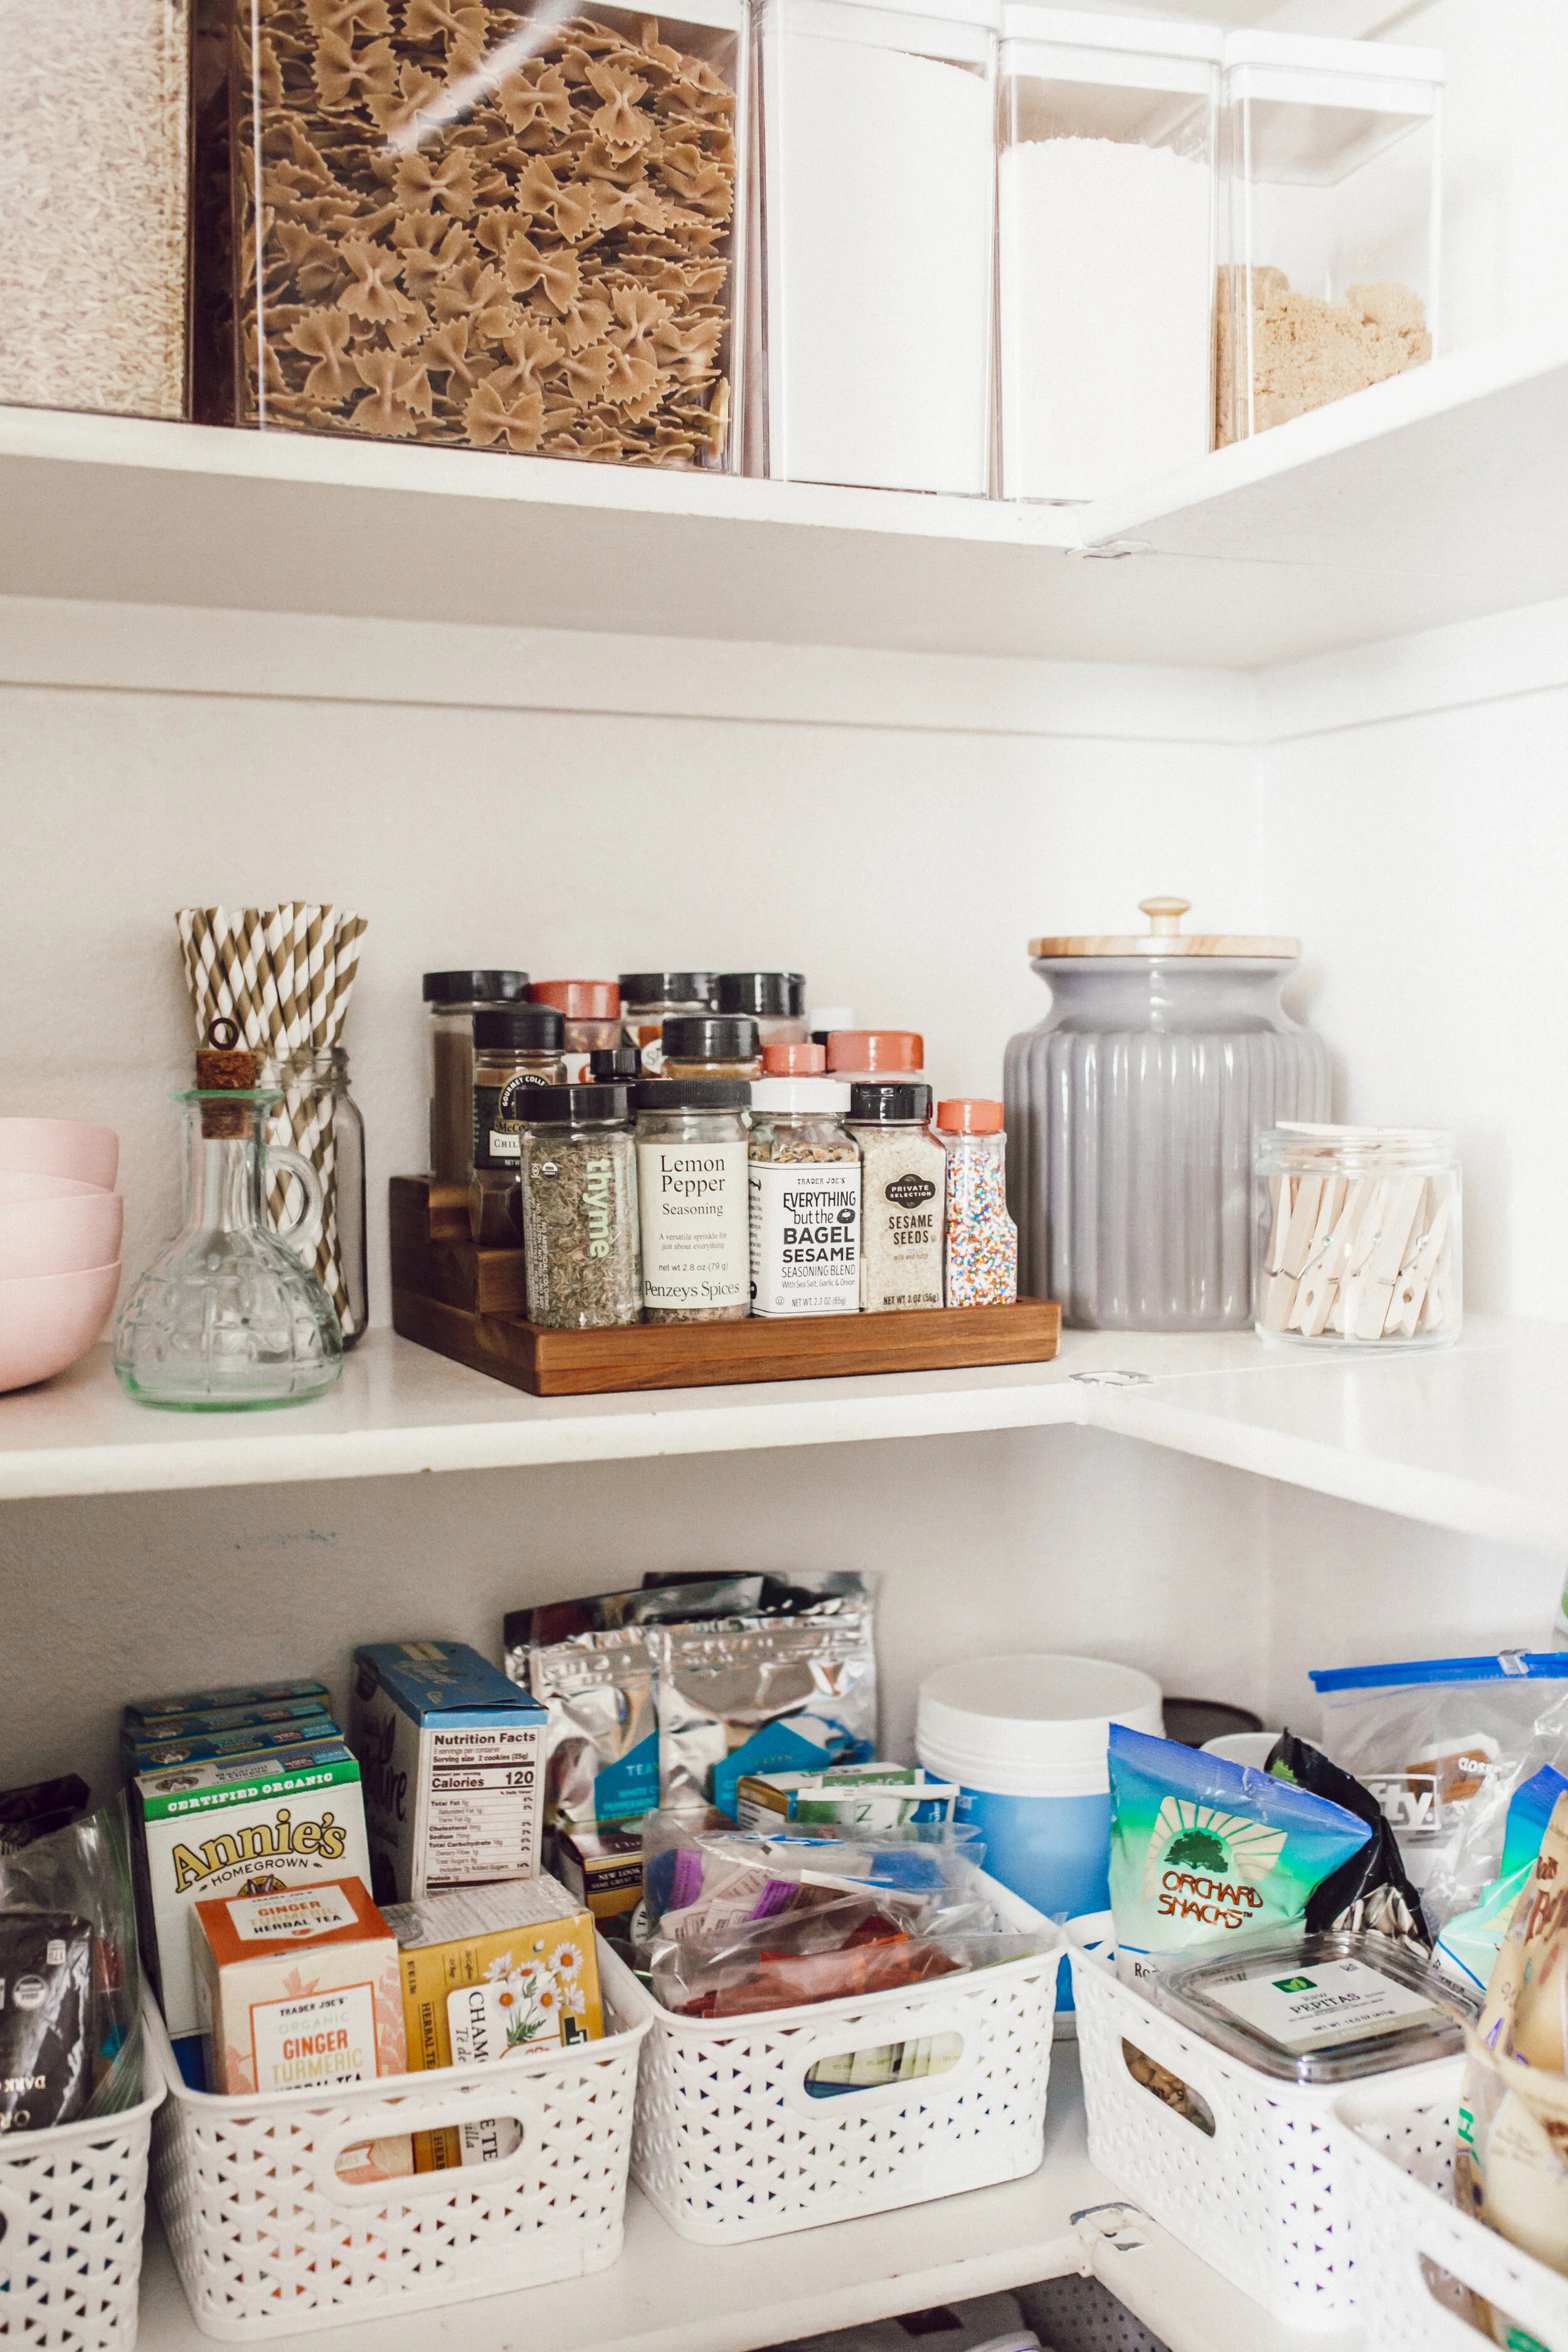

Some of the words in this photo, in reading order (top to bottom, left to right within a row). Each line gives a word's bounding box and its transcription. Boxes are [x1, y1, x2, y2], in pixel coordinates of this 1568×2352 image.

[502, 1076, 524, 1107] GOURMET
[660, 1155, 726, 1173] Lemon
[662, 1175, 726, 1197] Pepper
[891, 1184, 930, 1192] PRIVATE
[583, 1158, 612, 1258] thyme
[784, 1191, 856, 1208] EVERYTHING
[662, 1202, 724, 1217] Seasoning
[794, 1210, 813, 1224] but
[815, 1209, 834, 1224] the
[889, 1214, 933, 1230] SESAME
[693, 1232, 718, 1242] sprinkle
[784, 1226, 855, 1245] BAGEL
[893, 1231, 929, 1245] SEEDS
[661, 1242, 673, 1252] just
[693, 1242, 725, 1252] everything
[782, 1247, 855, 1263] SESAME
[682, 1263, 695, 1271] 2.8
[781, 1265, 829, 1278] SEASONING
[830, 1264, 856, 1276] BLEND
[645, 1280, 699, 1301] Penzeys
[701, 1281, 740, 1300] Spices
[781, 1280, 796, 1289] With
[819, 1278, 834, 1287] Garlic
[840, 1278, 856, 1286] Onion
[792, 1298, 802, 1306] NET
[815, 1298, 823, 1306] 2.3
[824, 1297, 831, 1305] OZ
[883, 1296, 895, 1305] NET
[896, 1295, 905, 1304] WT
[913, 1293, 921, 1303] OZ
[434, 1734, 495, 1745] Nutrition
[499, 1732, 536, 1743] Facts
[432, 1777, 484, 1788] Calories
[506, 1770, 534, 1785] 120
[167, 1787, 258, 1812] CERTIFIED
[262, 1772, 334, 1795] ORGANIC
[172, 1808, 347, 1894] Annie's
[211, 1858, 308, 1887] HOMEGROWN
[598, 1870, 617, 1881] NEW
[618, 1867, 641, 1878] LOOK
[591, 1880, 610, 1889] SAME
[1162, 1870, 1264, 1908] ORCHARD
[248, 1906, 337, 1927] TURMERIC
[258, 1900, 321, 1917] GINGER
[253, 1919, 310, 1934] HERBAL
[315, 1914, 343, 1924] TEA
[280, 2002, 317, 2017] TRADER
[319, 1997, 344, 2010] JOE'S
[1289, 1992, 1361, 2015] PEPITAS
[278, 2011, 350, 2035] ORGANIC
[421, 2002, 435, 2050] HERBAL
[469, 1991, 489, 2062] CHAM
[283, 2028, 348, 2061] GINGER
[456, 2028, 469, 2045] Té
[458, 2047, 472, 2062] de
[272, 2047, 364, 2085] TURMERIC
[3, 2075, 46, 2094] DARK
